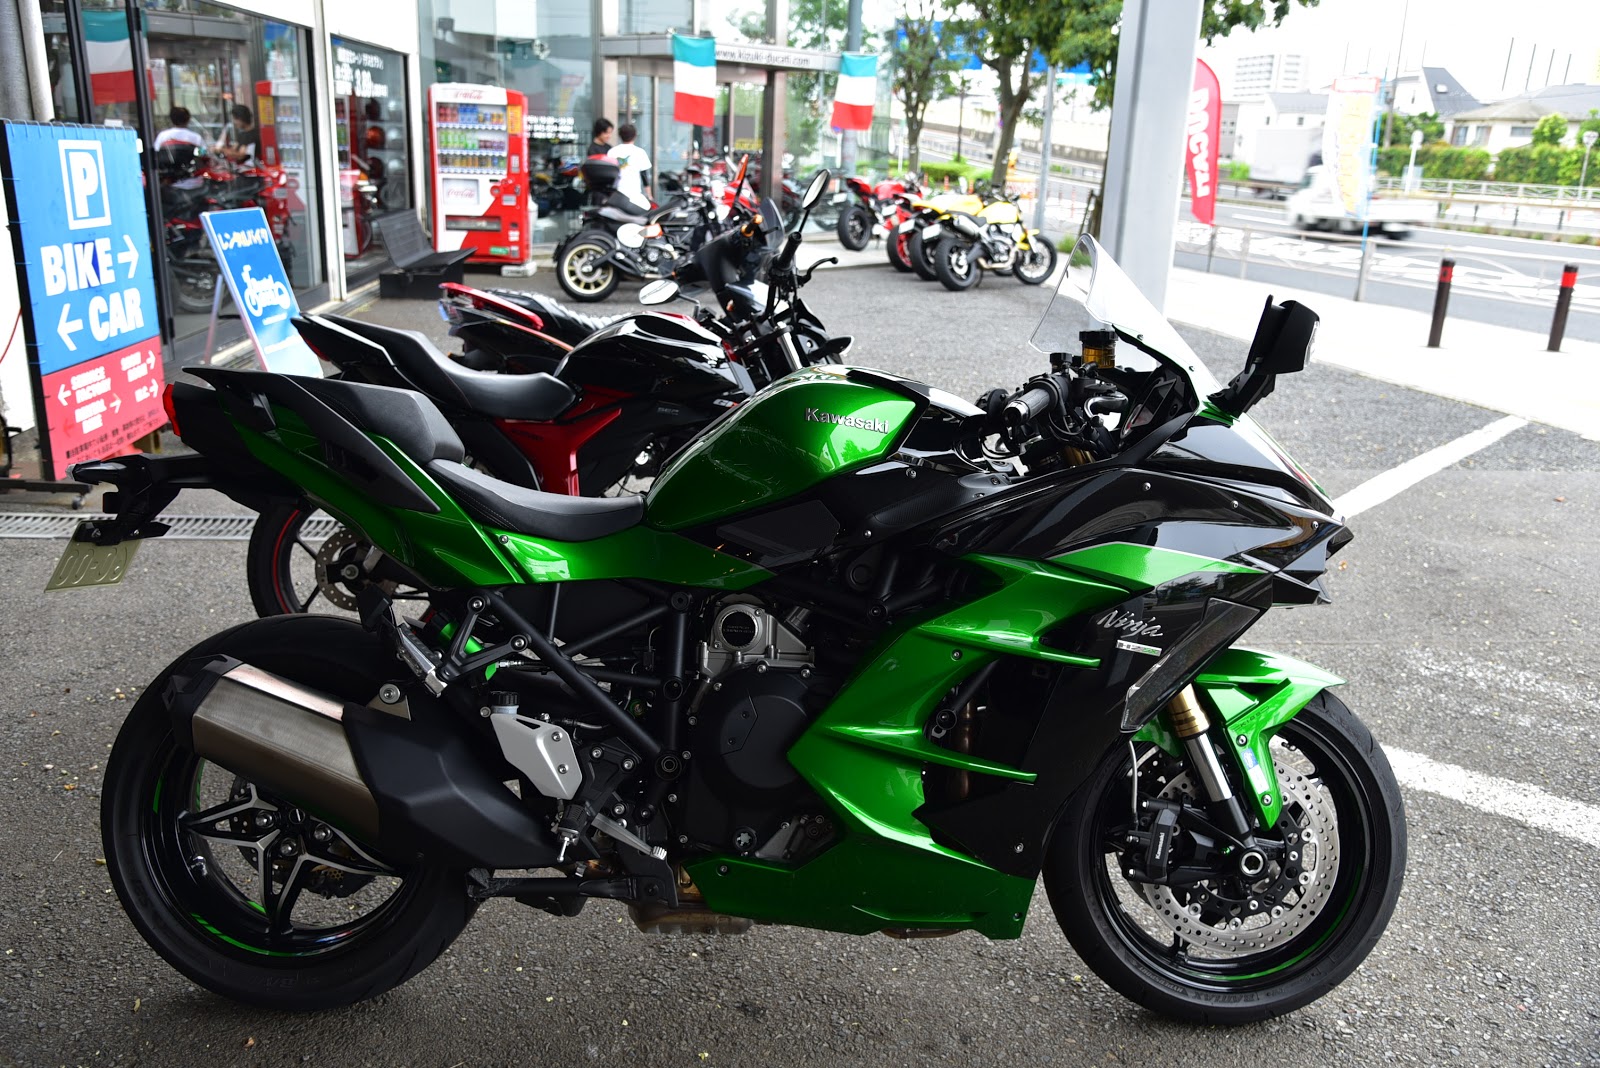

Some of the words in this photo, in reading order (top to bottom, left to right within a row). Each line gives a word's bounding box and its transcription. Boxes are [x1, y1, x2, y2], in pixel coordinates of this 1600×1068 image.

[68, 151, 99, 218] P
[40, 237, 116, 296] BIKE
[88, 287, 144, 342] CAR
[805, 407, 889, 434] Kawasaki
[1096, 609, 1163, 638] Ninja
[1155, 832, 1165, 860] Kawasaki
